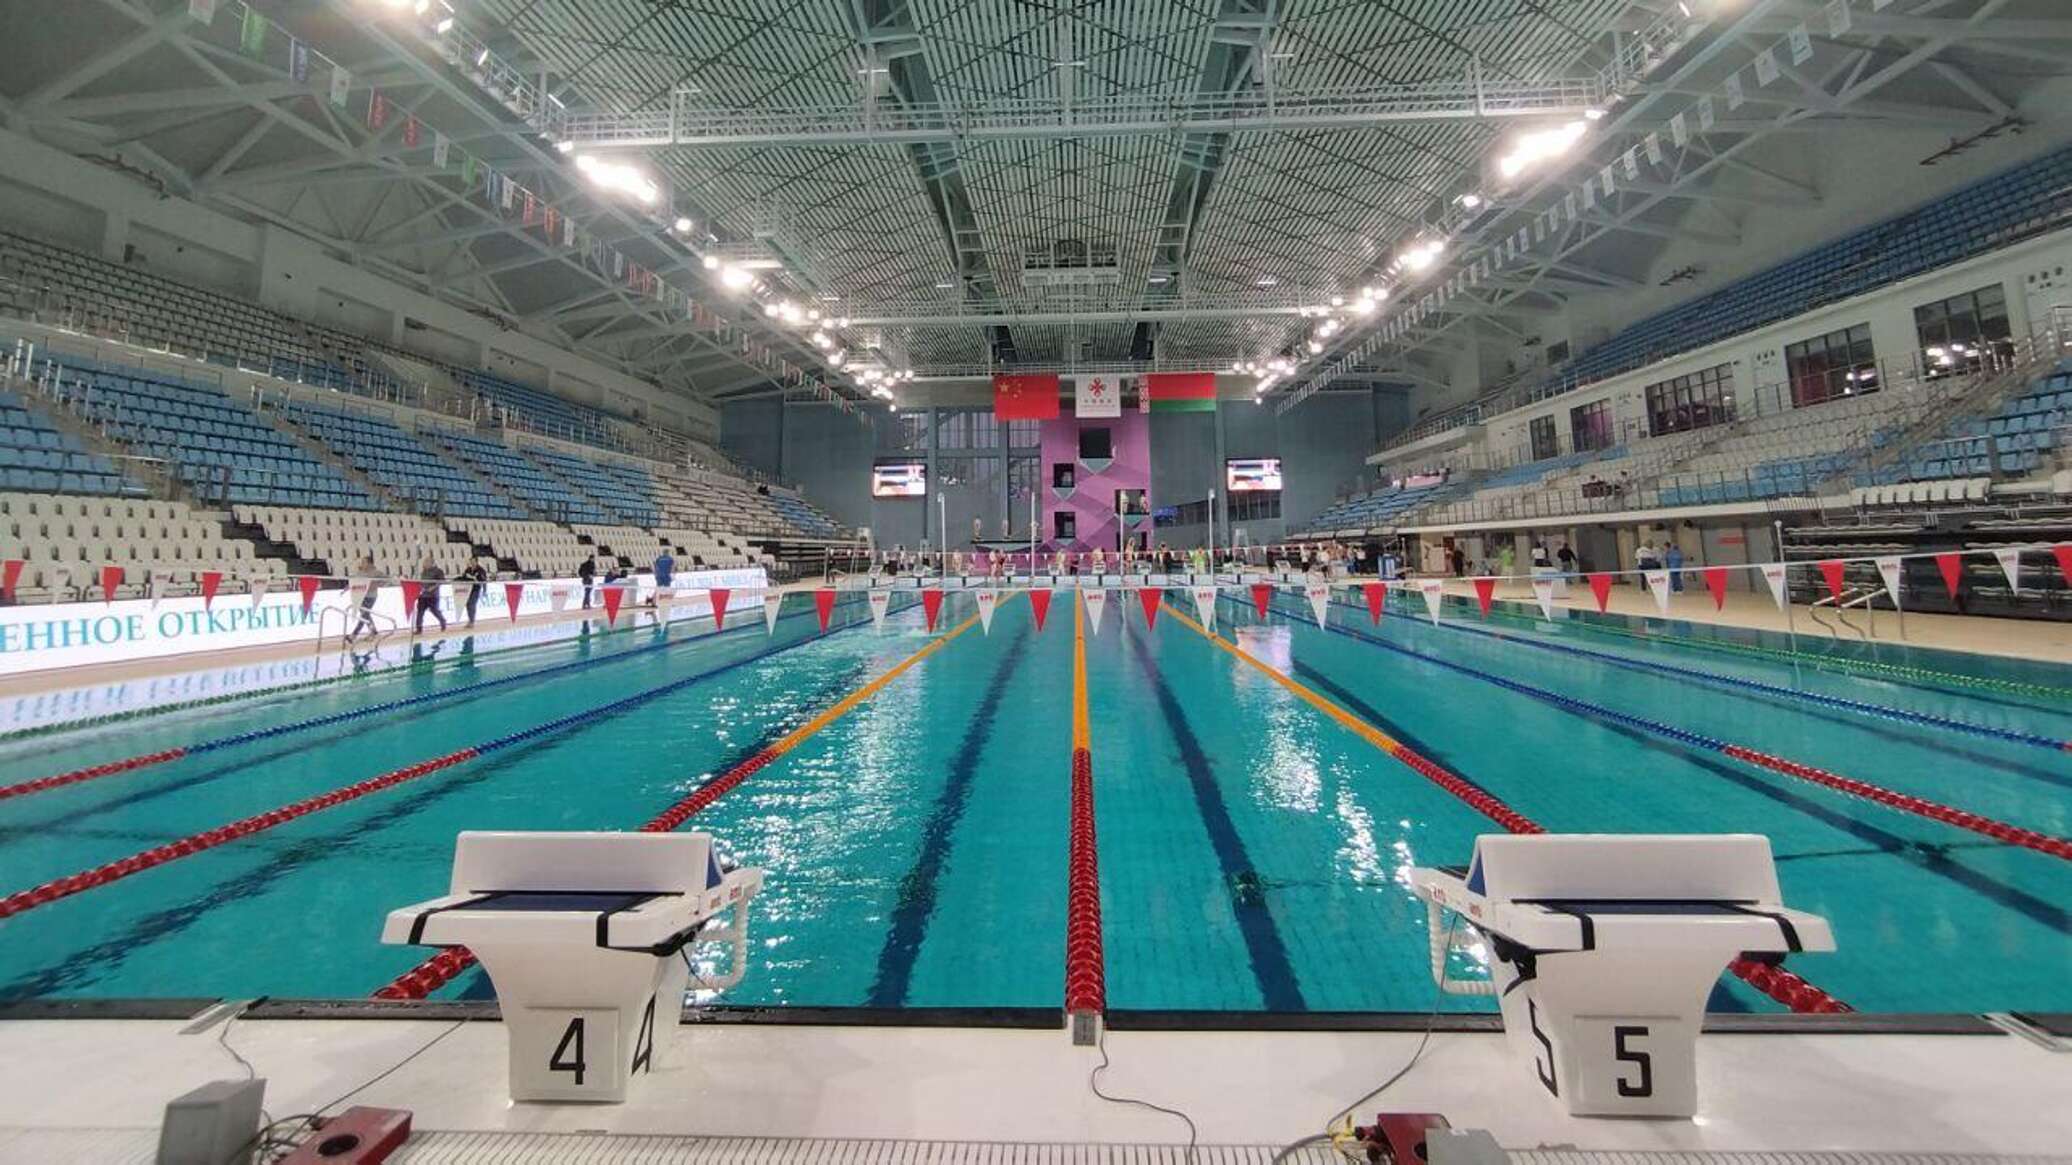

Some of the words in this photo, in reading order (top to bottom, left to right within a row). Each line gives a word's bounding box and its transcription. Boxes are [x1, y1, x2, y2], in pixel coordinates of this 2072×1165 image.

[0, 614, 146, 653] ЕННОЕ
[157, 603, 320, 639] ОТКРЫТИЕ
[549, 1017, 586, 1085] 4
[631, 992, 656, 1076] 4
[1614, 1025, 1653, 1098] 5
